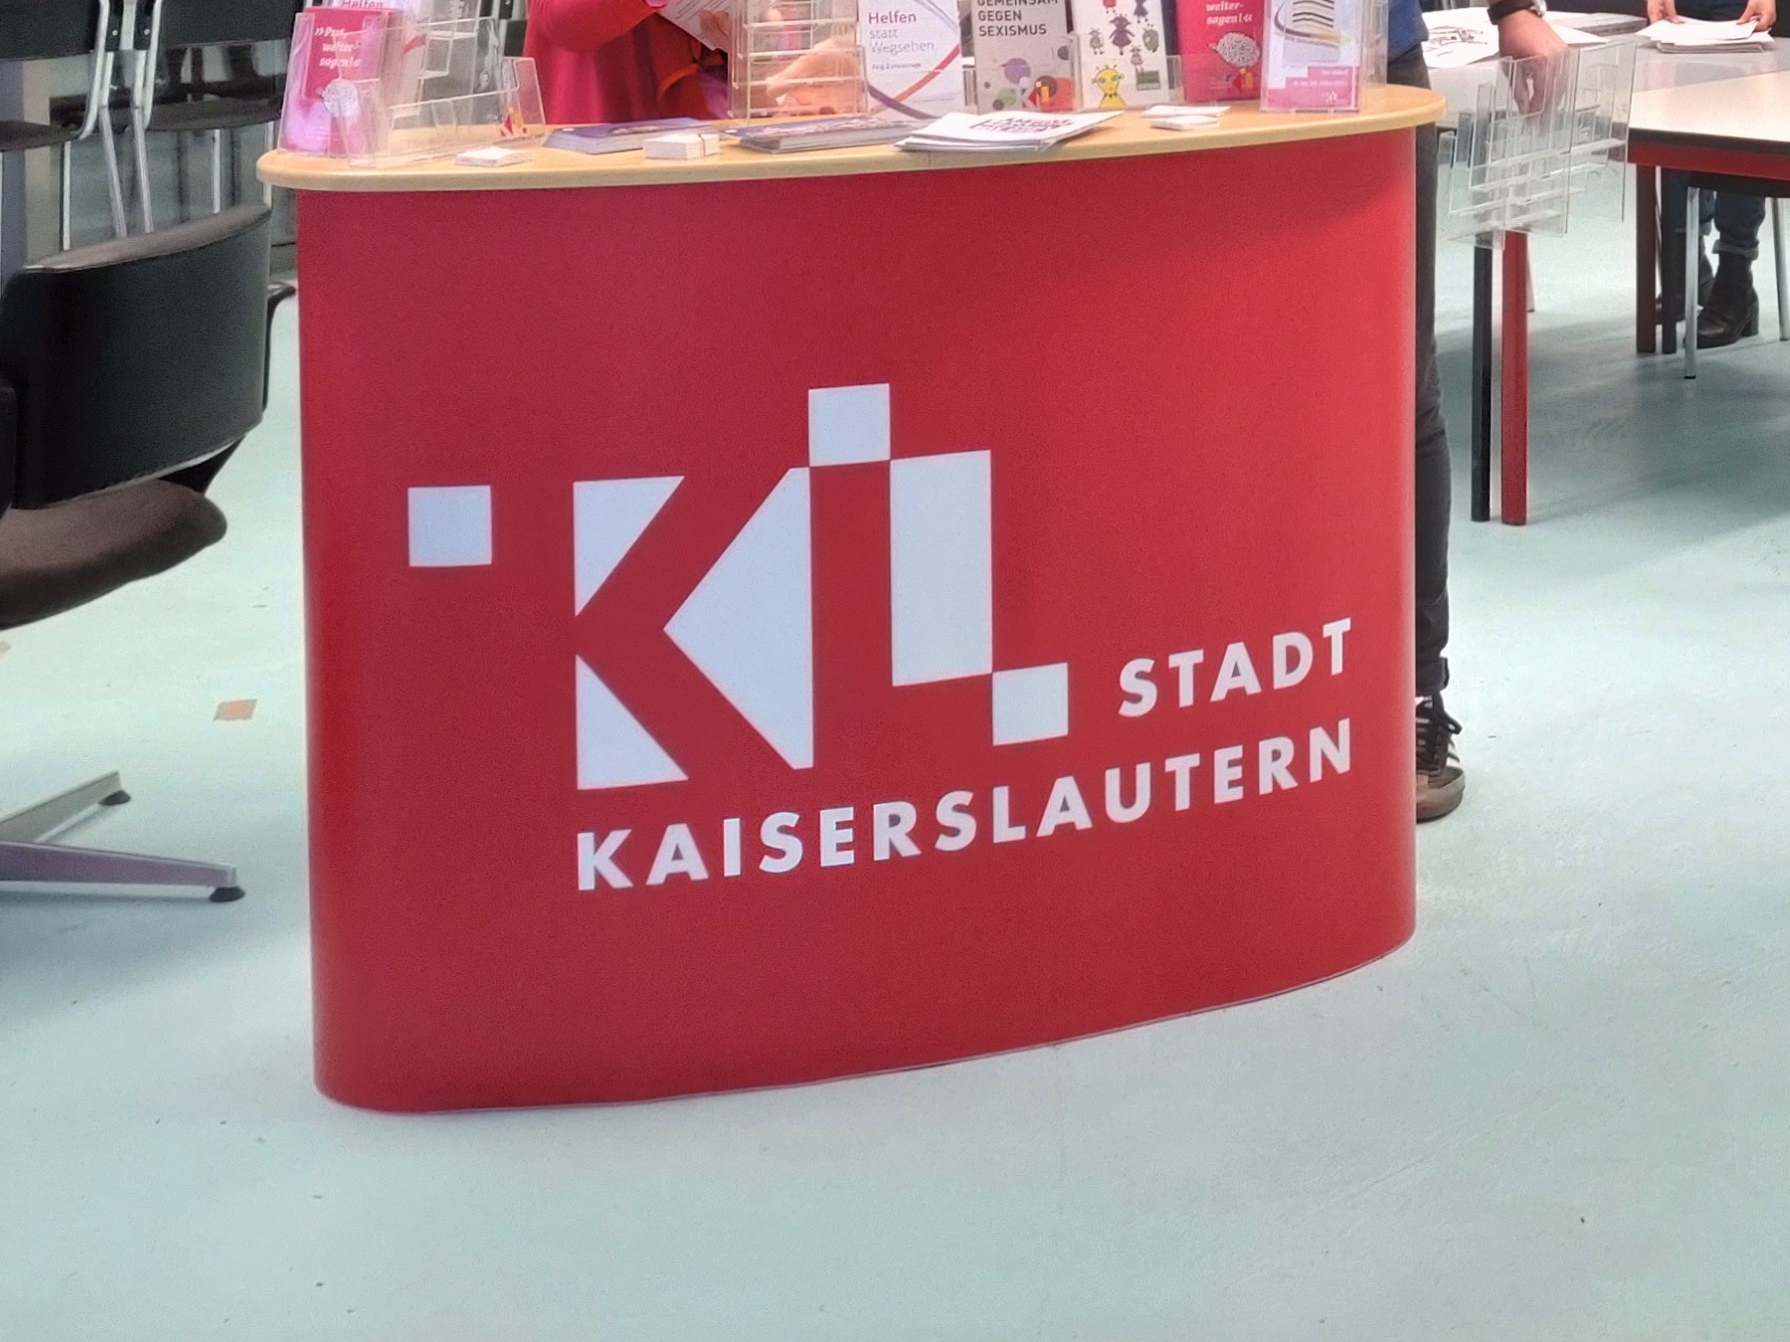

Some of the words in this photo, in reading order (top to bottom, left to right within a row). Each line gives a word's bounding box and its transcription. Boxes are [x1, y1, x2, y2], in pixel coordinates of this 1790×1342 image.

[868, 10, 917, 24] Helfen
[978, 10, 1022, 21] GEGEN
[869, 28, 898, 39] statt
[979, 24, 1047, 36] SEXISMUS
[1118, 617, 1352, 717] STADT
[577, 717, 1351, 891] KAISERSLAUTERN
